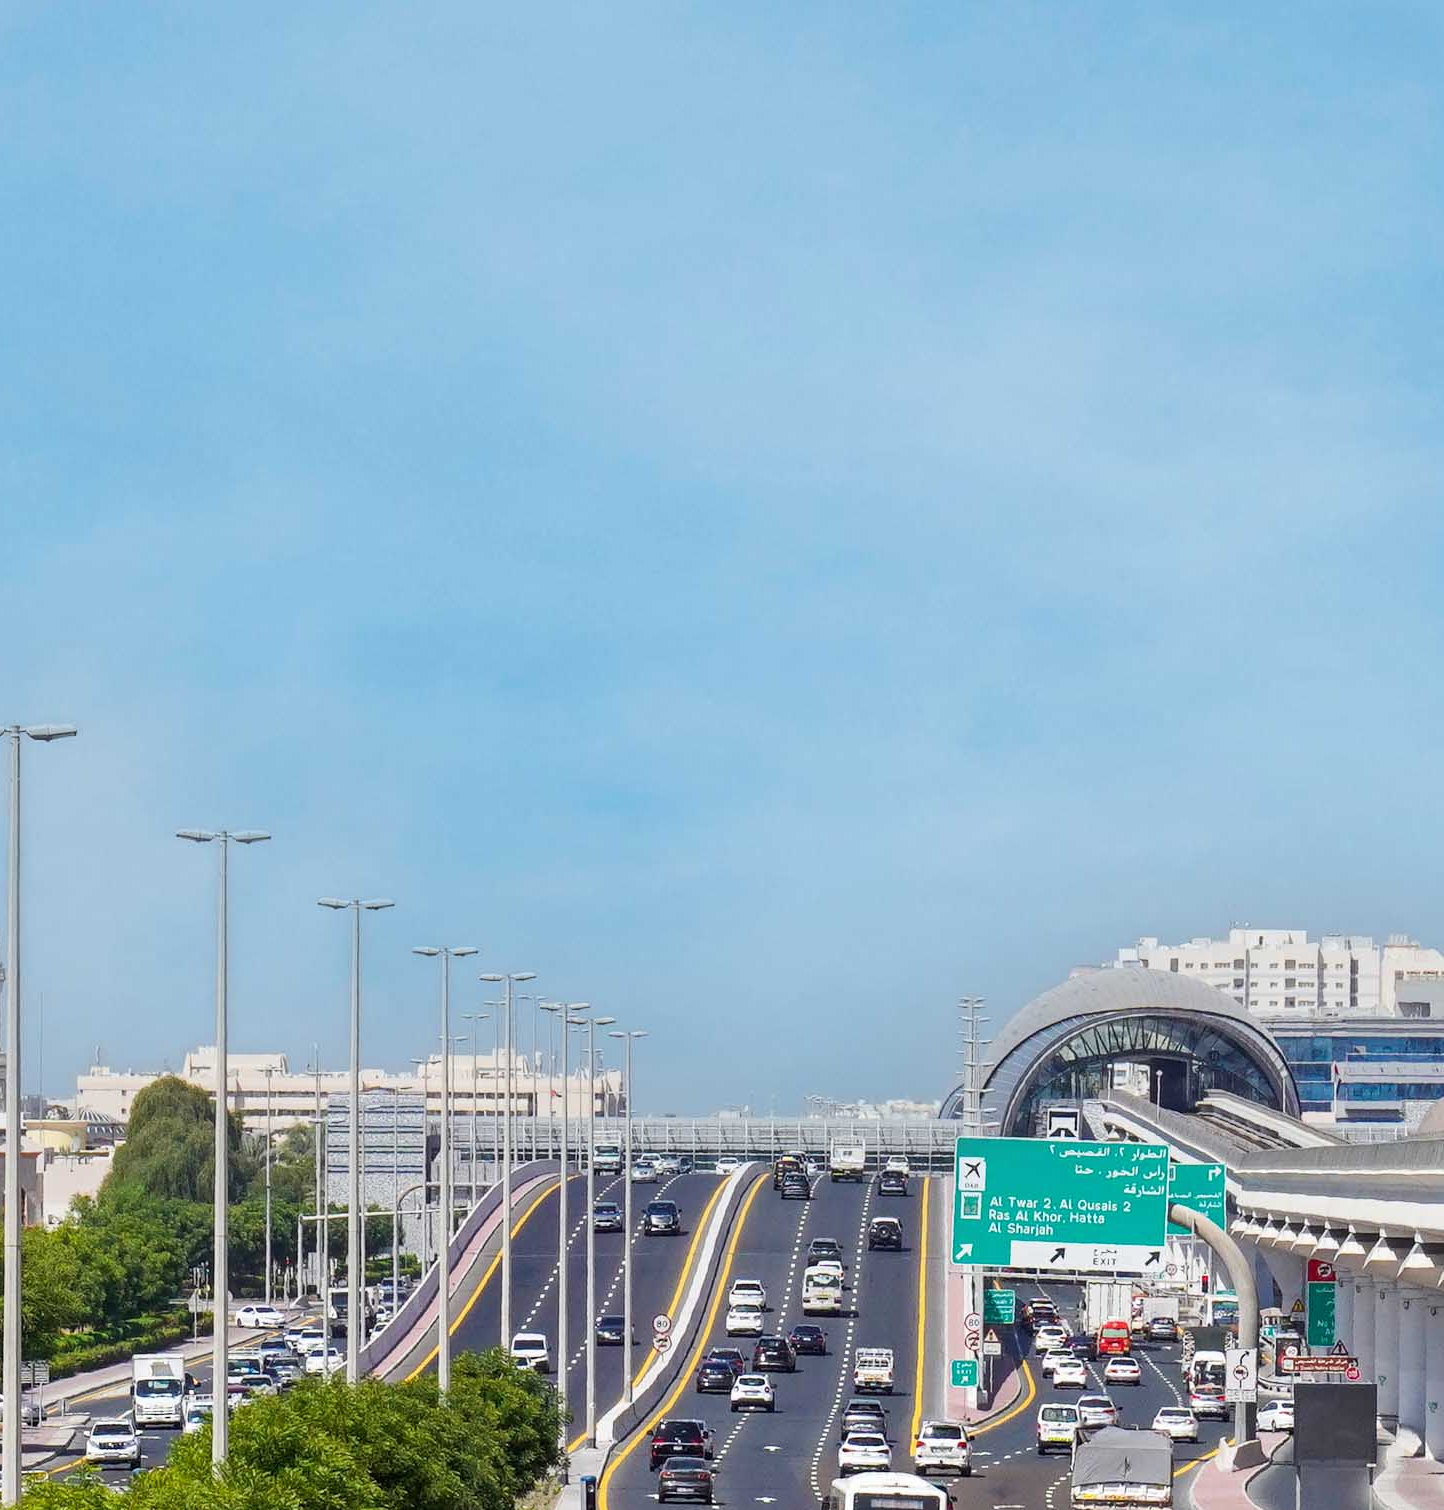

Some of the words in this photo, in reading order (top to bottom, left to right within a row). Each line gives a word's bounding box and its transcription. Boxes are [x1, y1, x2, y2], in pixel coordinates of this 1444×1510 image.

[1059, 1146, 1111, 1158] القصيص
[1132, 1148, 1167, 1161] الطوار
[1123, 1183, 1165, 1198] الشارقة
[989, 1196, 1002, 1207] Al
[1008, 1197, 1038, 1208] Twar
[1059, 1199, 1072, 1210] Al
[1077, 1200, 1118, 1212] Qusais
[1123, 1201, 1132, 1212] 2
[988, 1209, 1010, 1221] Ras
[1015, 1210, 1029, 1221] Al
[1069, 1212, 1105, 1224] Hatta
[988, 1222, 1001, 1233] Al
[1007, 1223, 1054, 1237] Sharjah
[1092, 1257, 1117, 1266] EXIT
[968, 1318, 980, 1327] 80
